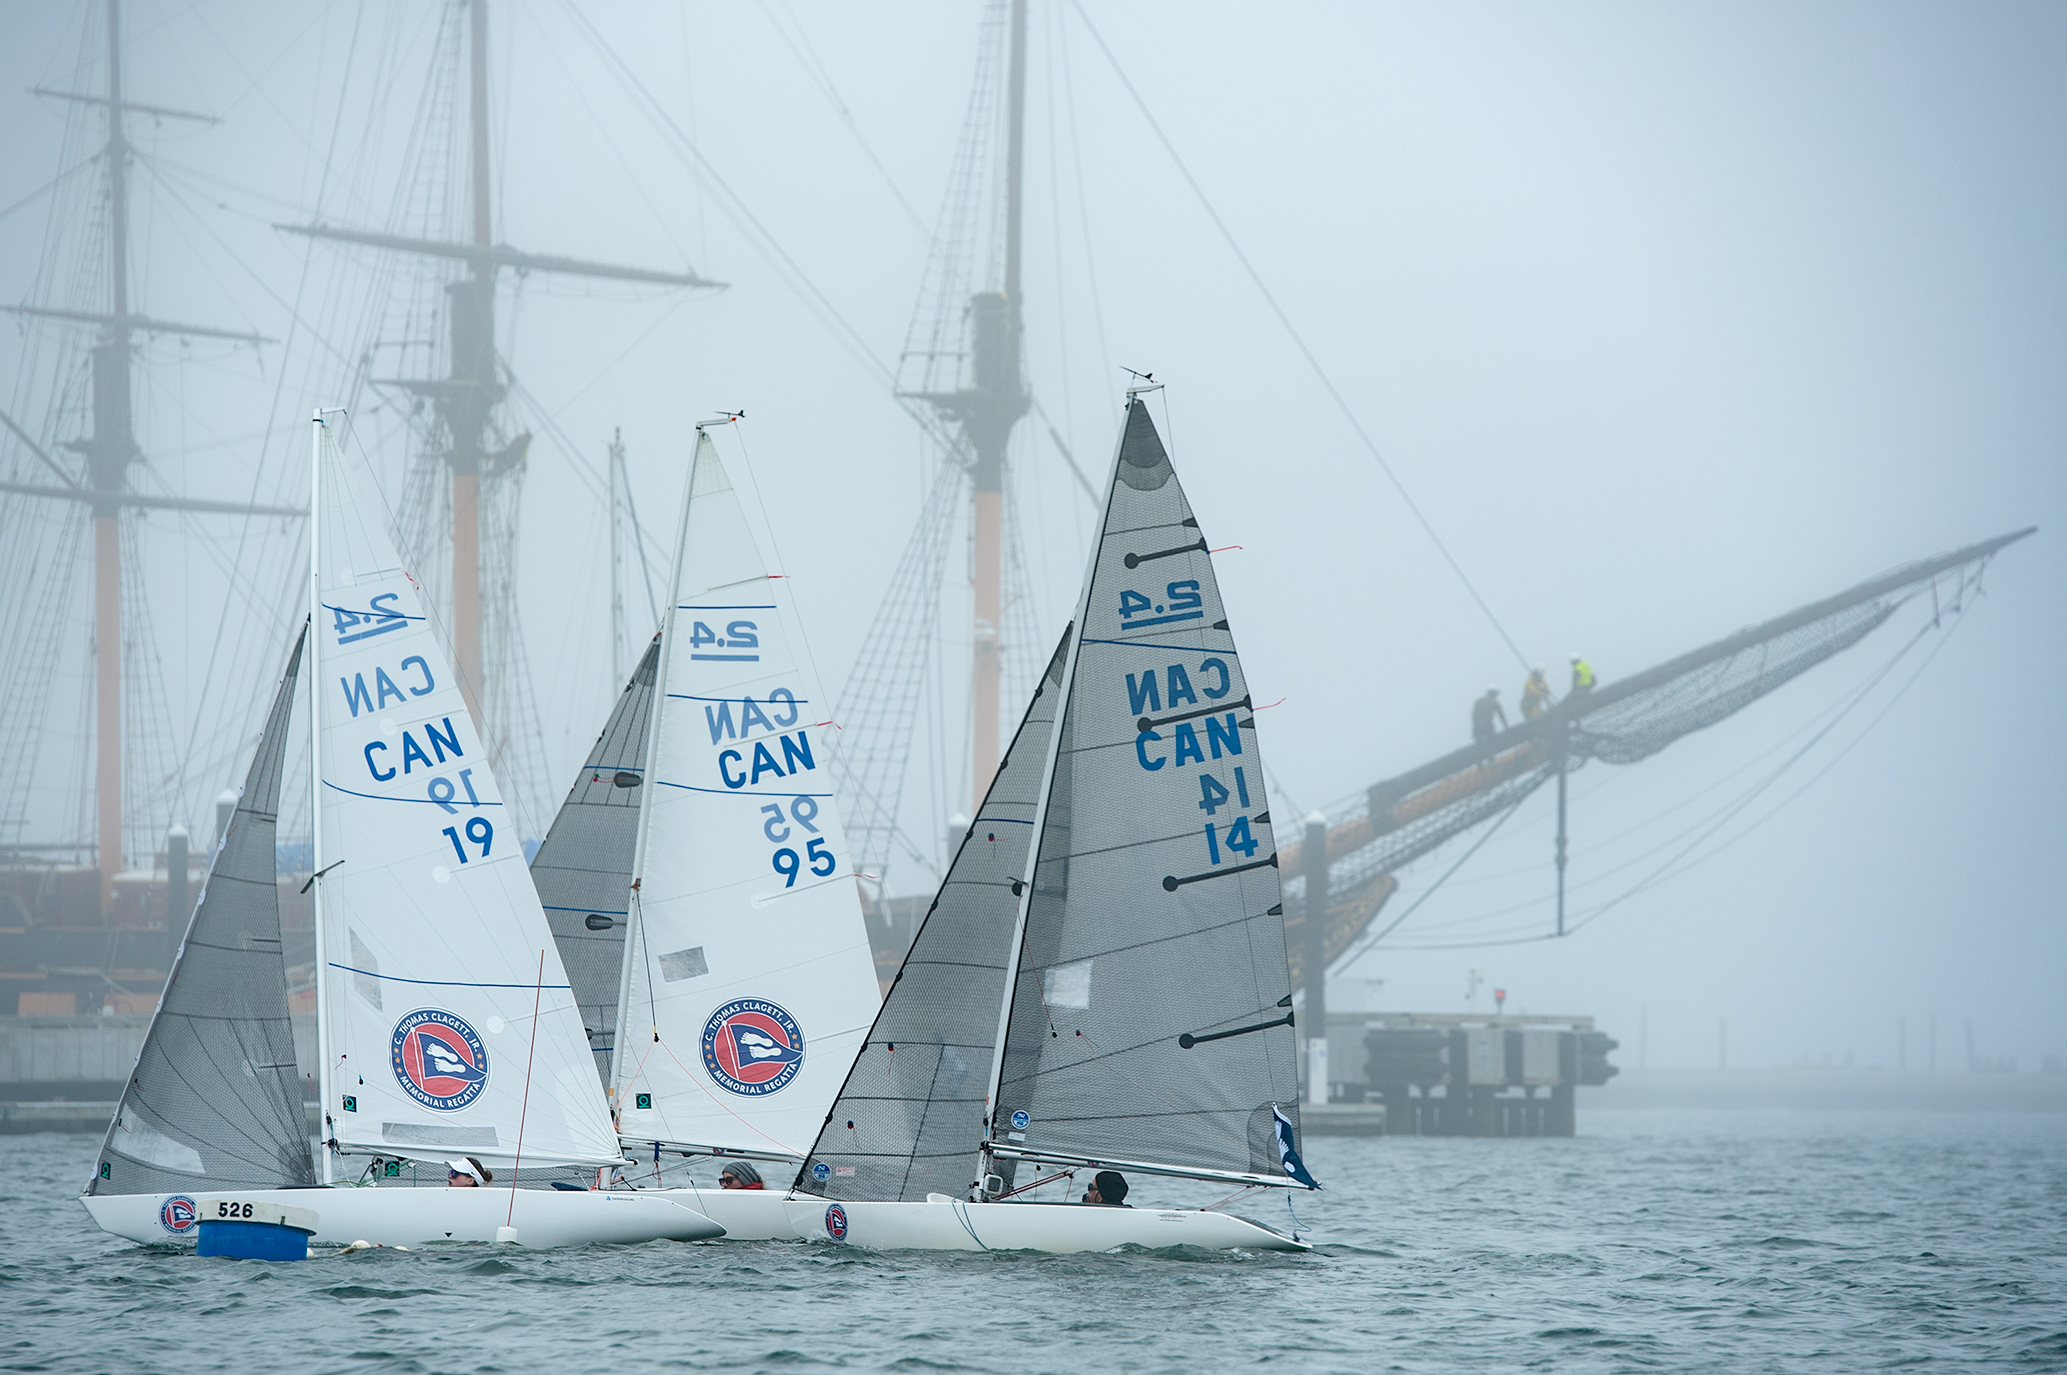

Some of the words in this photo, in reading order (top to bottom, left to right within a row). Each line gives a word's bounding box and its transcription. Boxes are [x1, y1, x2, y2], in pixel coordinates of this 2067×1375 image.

[363, 717, 464, 782] CAN
[718, 730, 816, 789] CAN
[1135, 713, 1243, 772] CAN
[442, 816, 494, 864] 19
[772, 837, 836, 889] 95
[1205, 815, 1259, 866] 14
[398, 1012, 429, 1035] THOMAS
[469, 1038, 480, 1052] JR.
[708, 1003, 741, 1031] THOMAS
[783, 1019, 795, 1034] JR.
[400, 1075, 445, 1108] MEMORIAL
[447, 1083, 481, 1108] REGATTA
[713, 1070, 762, 1094] MEMORIAL
[763, 1063, 797, 1092] REGATTA
[218, 1202, 254, 1219] 526
